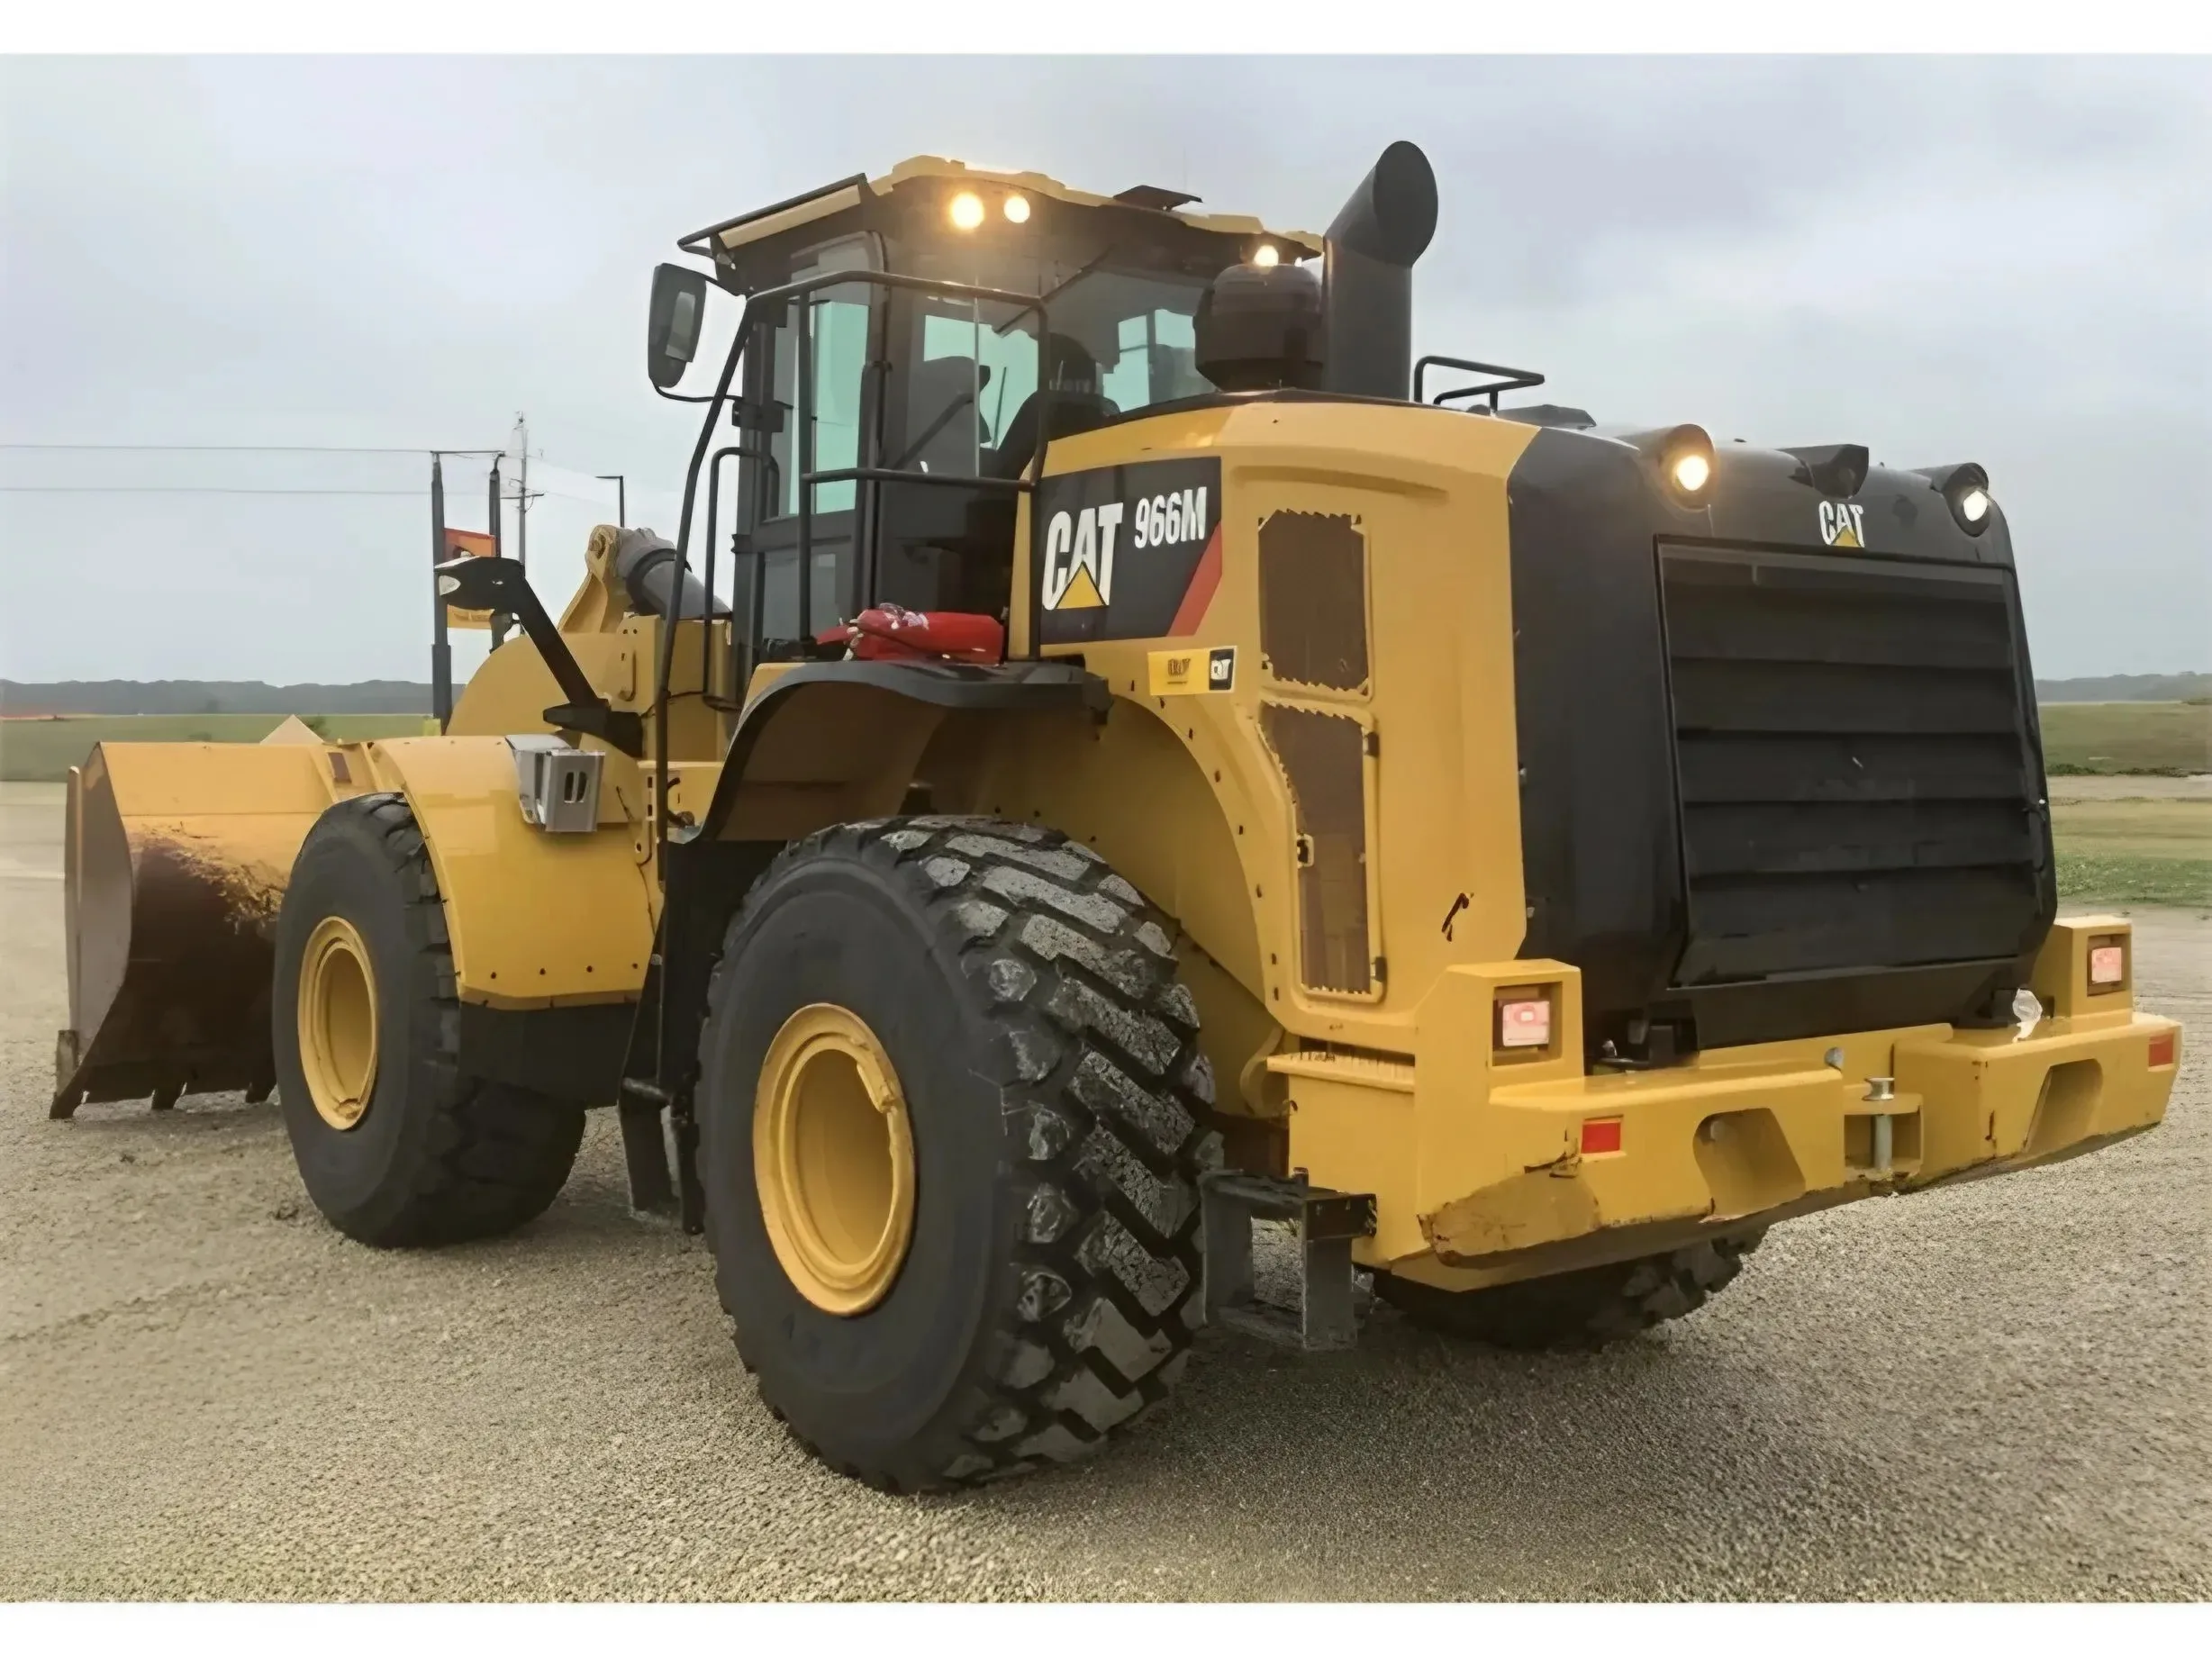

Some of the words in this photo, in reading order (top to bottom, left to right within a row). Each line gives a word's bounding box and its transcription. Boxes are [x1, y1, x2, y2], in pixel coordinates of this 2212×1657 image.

[1042, 503, 1123, 611] CAT
[1134, 486, 1207, 548] 966M
[1818, 501, 1865, 548] CAT
